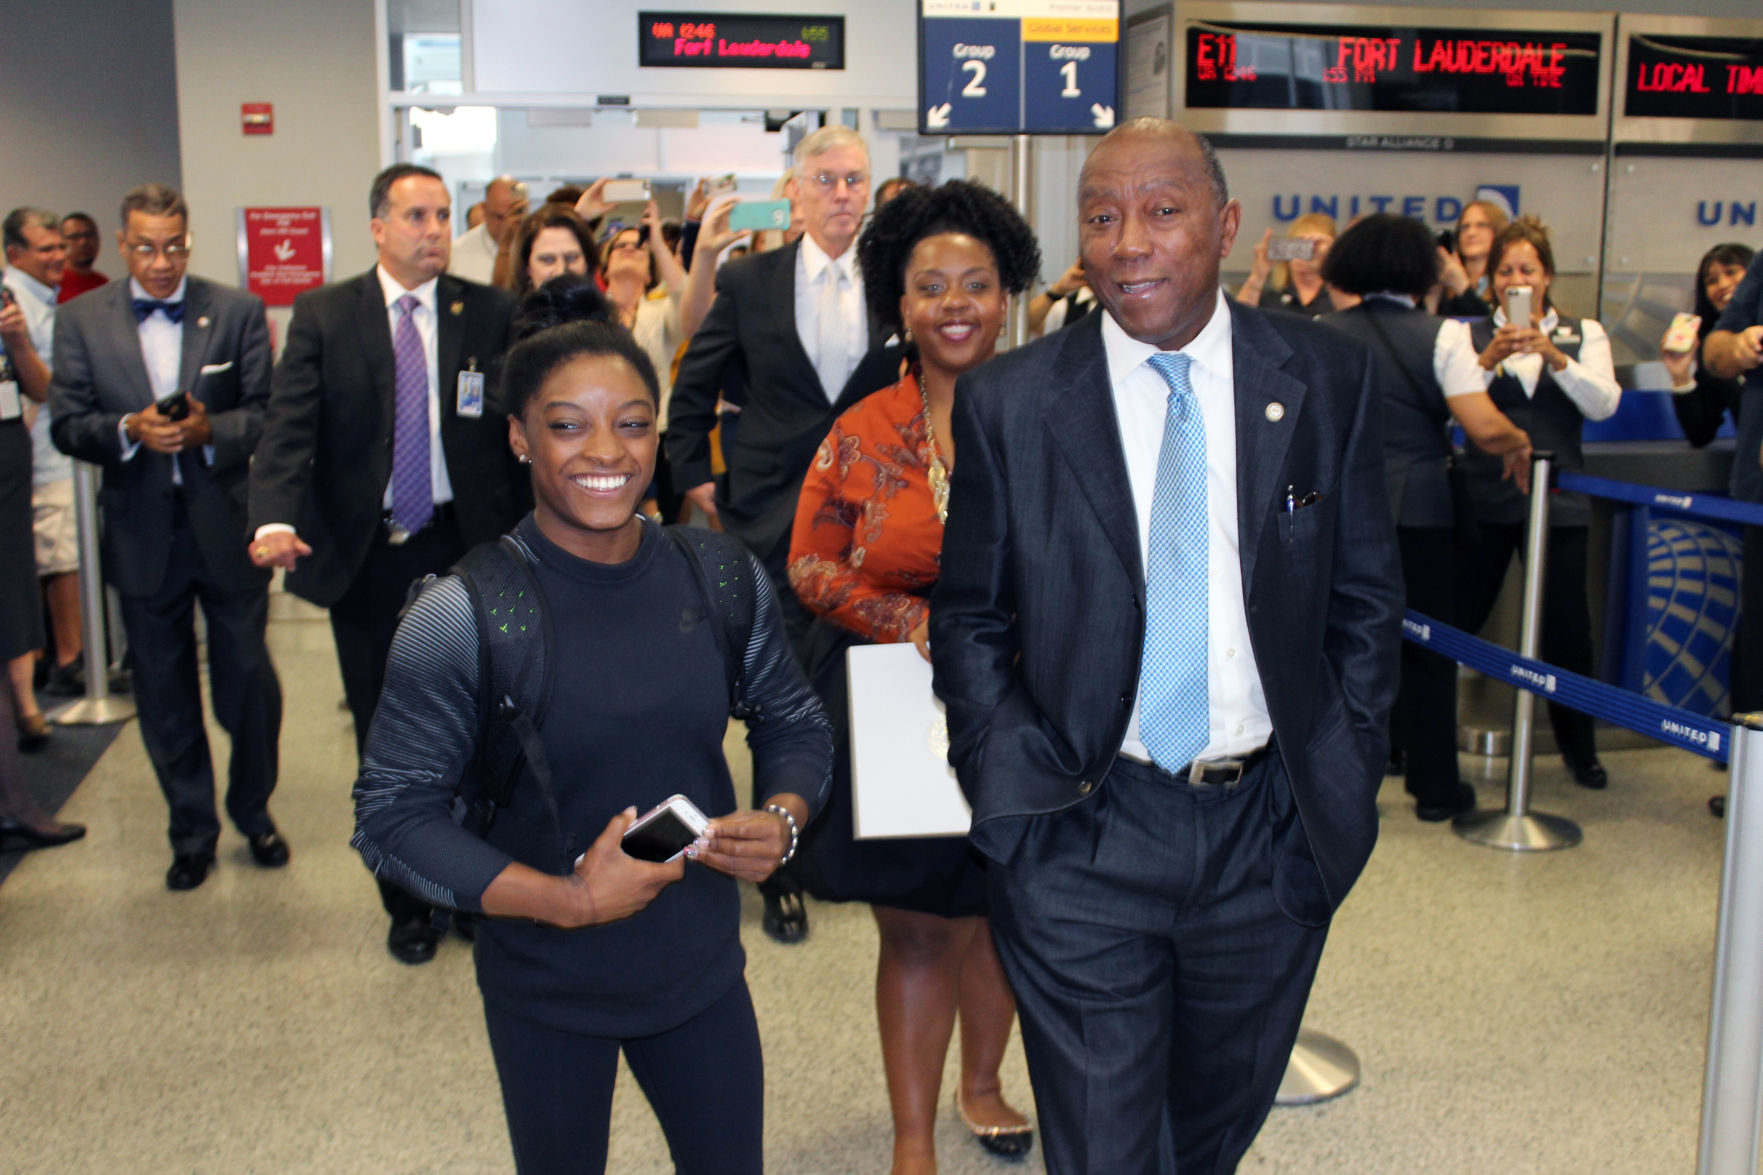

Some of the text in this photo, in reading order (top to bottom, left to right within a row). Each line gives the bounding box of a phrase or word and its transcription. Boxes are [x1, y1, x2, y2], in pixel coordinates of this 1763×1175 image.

[674, 38, 811, 58] Fort Lauderdale
[953, 43, 996, 60] Group
[1049, 44, 1091, 60] Group
[1337, 36, 1567, 76] FORT LAUDERDALE
[961, 59, 987, 97] 2
[1059, 60, 1081, 98] 1
[1637, 62, 1763, 94] LOCAL TIM
[1273, 194, 1462, 222] UNITED
[1511, 664, 1546, 686] UNITED
[1661, 719, 1707, 744] UNITED
